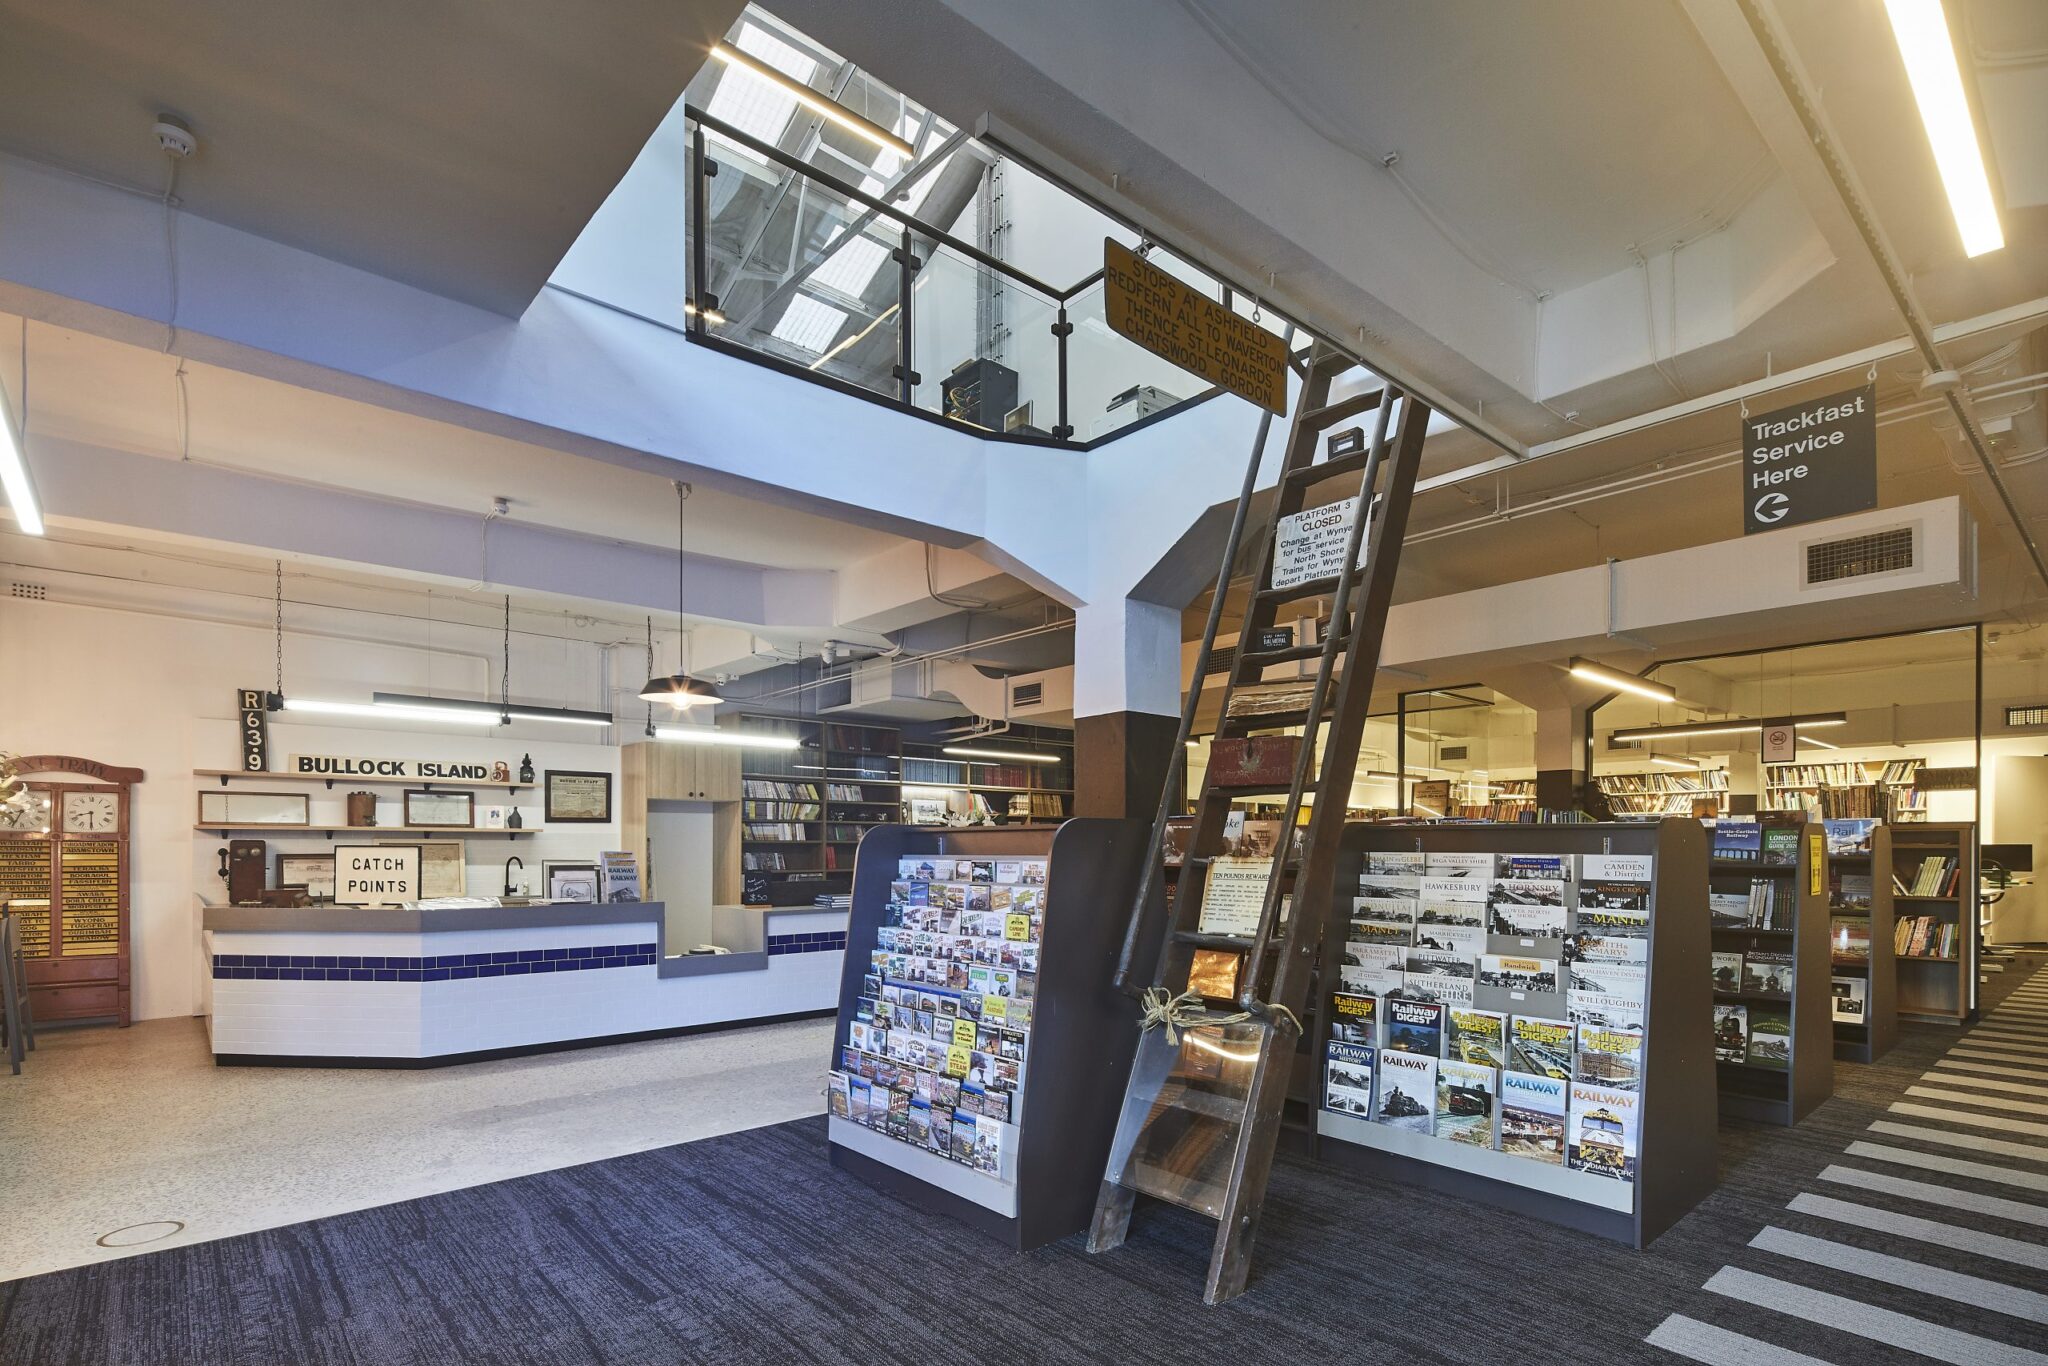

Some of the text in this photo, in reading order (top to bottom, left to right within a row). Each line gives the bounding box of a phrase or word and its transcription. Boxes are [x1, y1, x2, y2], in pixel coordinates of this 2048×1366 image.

[1132, 260, 1267, 348] STOPS AT ASHFIELD
[1108, 267, 1285, 376] REDFERN ALL TO WAVERTON
[1126, 297, 1180, 341] THENCE
[1221, 369, 1272, 405] GORDON
[1752, 396, 1865, 440] Trackfast
[1752, 431, 1844, 464] Service
[1753, 465, 1809, 489] Here
[1295, 504, 1341, 523] PLATFORM
[1302, 514, 1342, 532] CLOSED
[1280, 525, 1353, 549] Change at Wynya
[1282, 537, 1345, 558] for bus service
[1294, 546, 1345, 565] North Shore
[1282, 556, 1344, 577] Trains for Wyny
[1275, 568, 1339, 588] depart Platform
[245, 692, 258, 708] R
[59, 759, 104, 777] TRAIN
[298, 756, 488, 779] BULLOCK ISLAND
[1832, 827, 1855, 836] Rail
[352, 858, 404, 871] CATCH
[1604, 863, 1645, 871] CAMDEN
[1614, 870, 1644, 878] District
[348, 880, 407, 893] POINTS
[1425, 882, 1482, 892] HAWKESBURY
[1509, 883, 1559, 892] HORNSBY
[1593, 913, 1646, 926] MANLY
[1360, 924, 1399, 935] MANLY
[1352, 947, 1397, 957] PARRAMATTA
[1418, 953, 1461, 963] PITTWATER
[1504, 962, 1537, 971] Randwick
[1409, 979, 1469, 992] SUTHERLAND
[1434, 989, 1472, 1001] SHIRE
[1577, 995, 1643, 1009] WILLOUGHBY
[1334, 996, 1374, 1012] Railway
[1338, 1006, 1368, 1016] DIGEST
[1392, 1002, 1439, 1020] Railway
[1396, 1012, 1431, 1025] DIGEST
[1452, 1010, 1499, 1030] Railway
[1458, 1021, 1493, 1034] DIGEST
[1515, 1019, 1570, 1039] Railway
[1520, 1032, 1561, 1043] DIGEST
[1581, 1028, 1642, 1049] Railway
[1329, 1046, 1372, 1061] RAILWAY
[1587, 1041, 1632, 1054] DIGEST
[949, 1061, 967, 1070] STEAM
[1383, 1055, 1428, 1071] RAILWAY
[1505, 1079, 1561, 1096] RAILWAY
[1573, 1089, 1634, 1108] RAILWAY
[1570, 1159, 1583, 1167] THE
[1583, 1161, 1608, 1172] INDIAN
